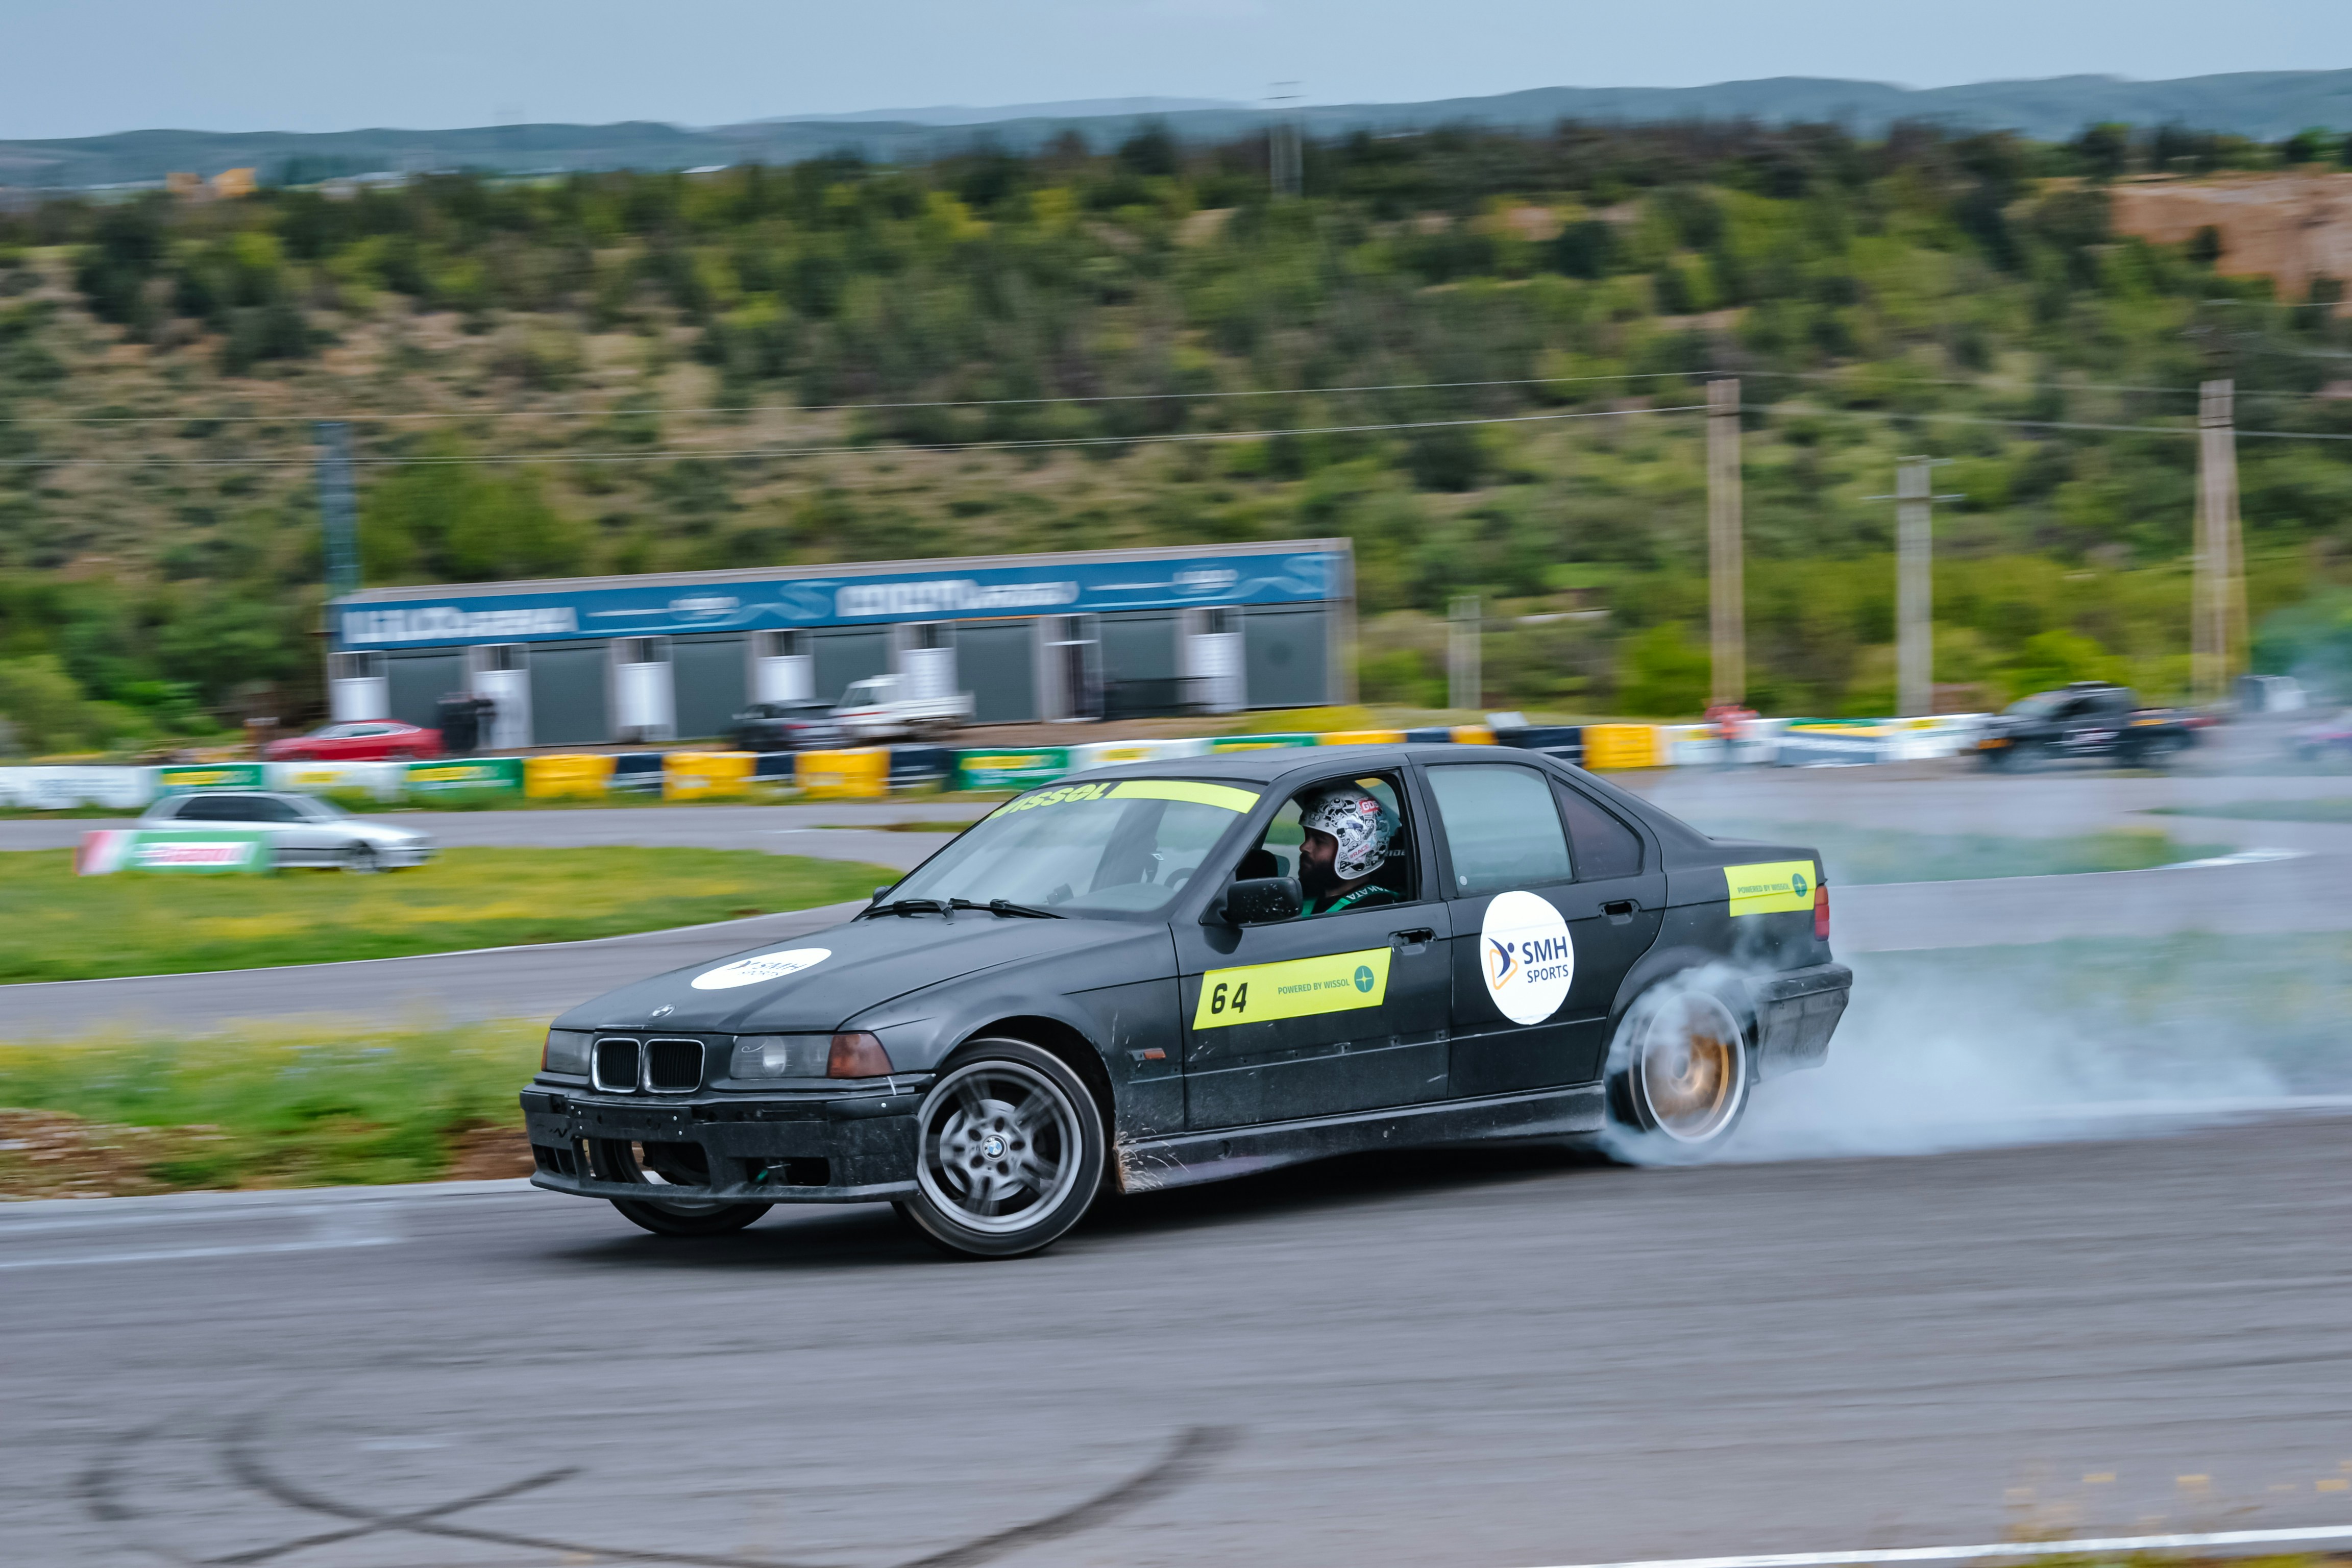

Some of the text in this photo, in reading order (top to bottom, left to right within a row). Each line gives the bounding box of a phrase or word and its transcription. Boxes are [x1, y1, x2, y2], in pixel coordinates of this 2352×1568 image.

[1522, 936, 1568, 964] SMH
[1527, 964, 1569, 983] SPORTS
[1211, 982, 1248, 1014] 64
[1278, 978, 1350, 995] POWERED BY WISSOL
